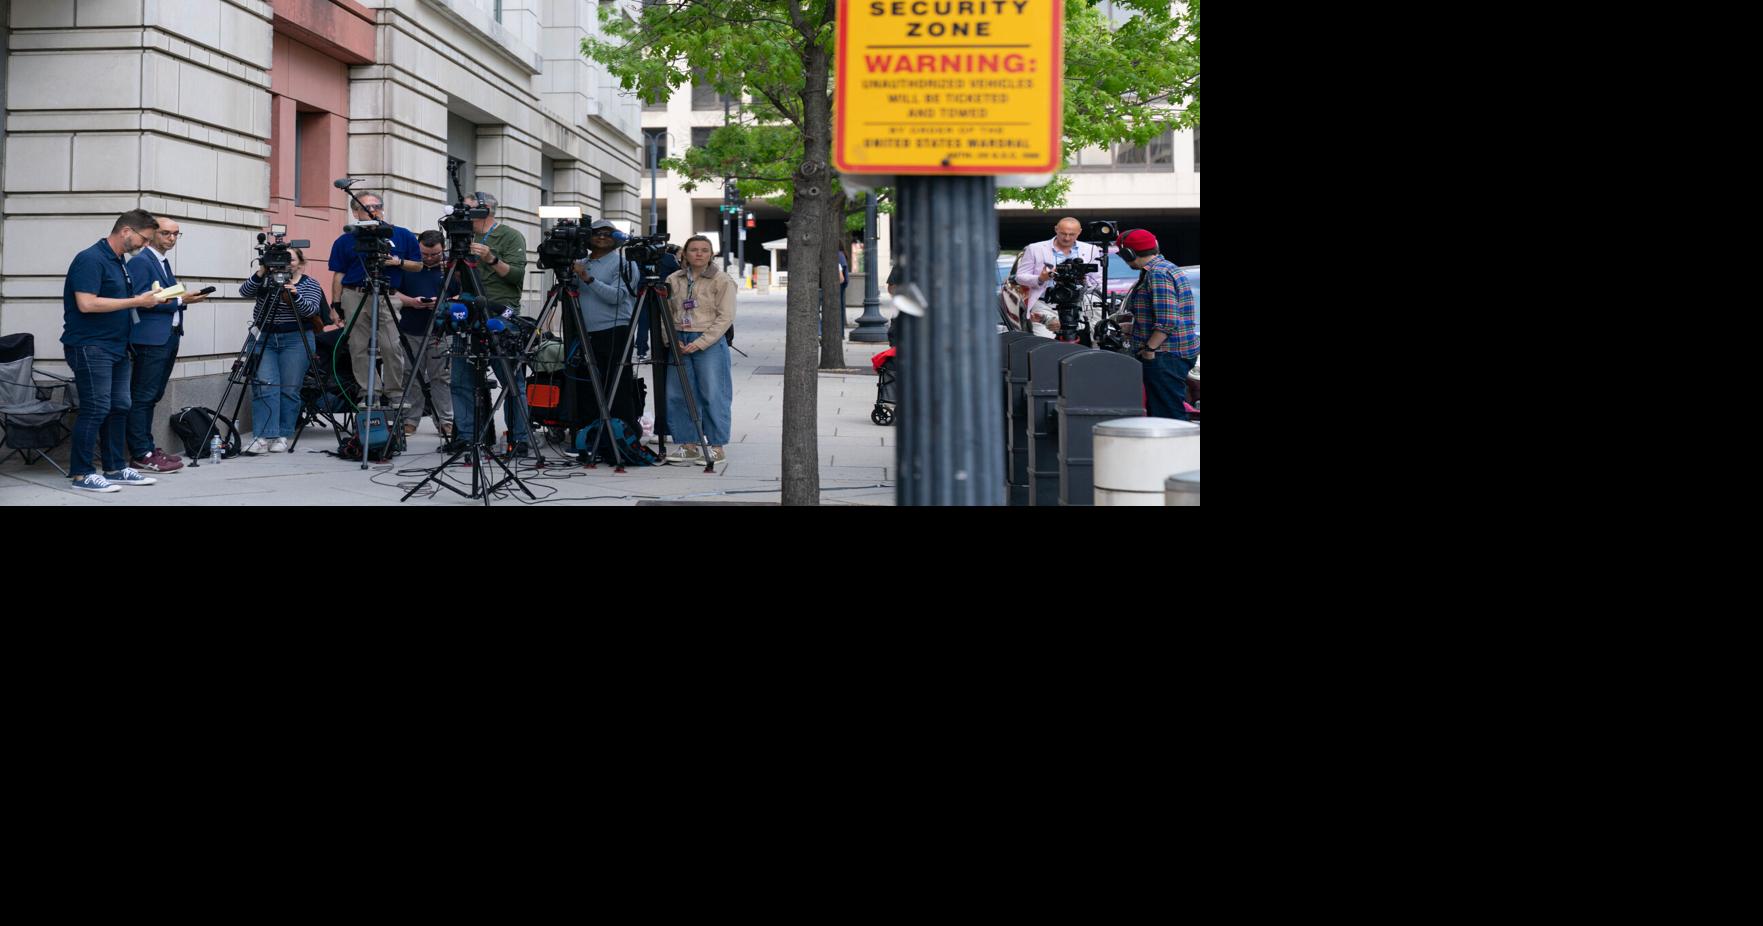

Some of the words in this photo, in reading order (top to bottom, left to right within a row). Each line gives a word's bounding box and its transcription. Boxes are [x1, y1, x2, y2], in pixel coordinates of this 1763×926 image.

[870, 0, 1028, 16] SECURITY
[906, 22, 991, 37] ZONE
[864, 54, 1037, 73] WARNING:
